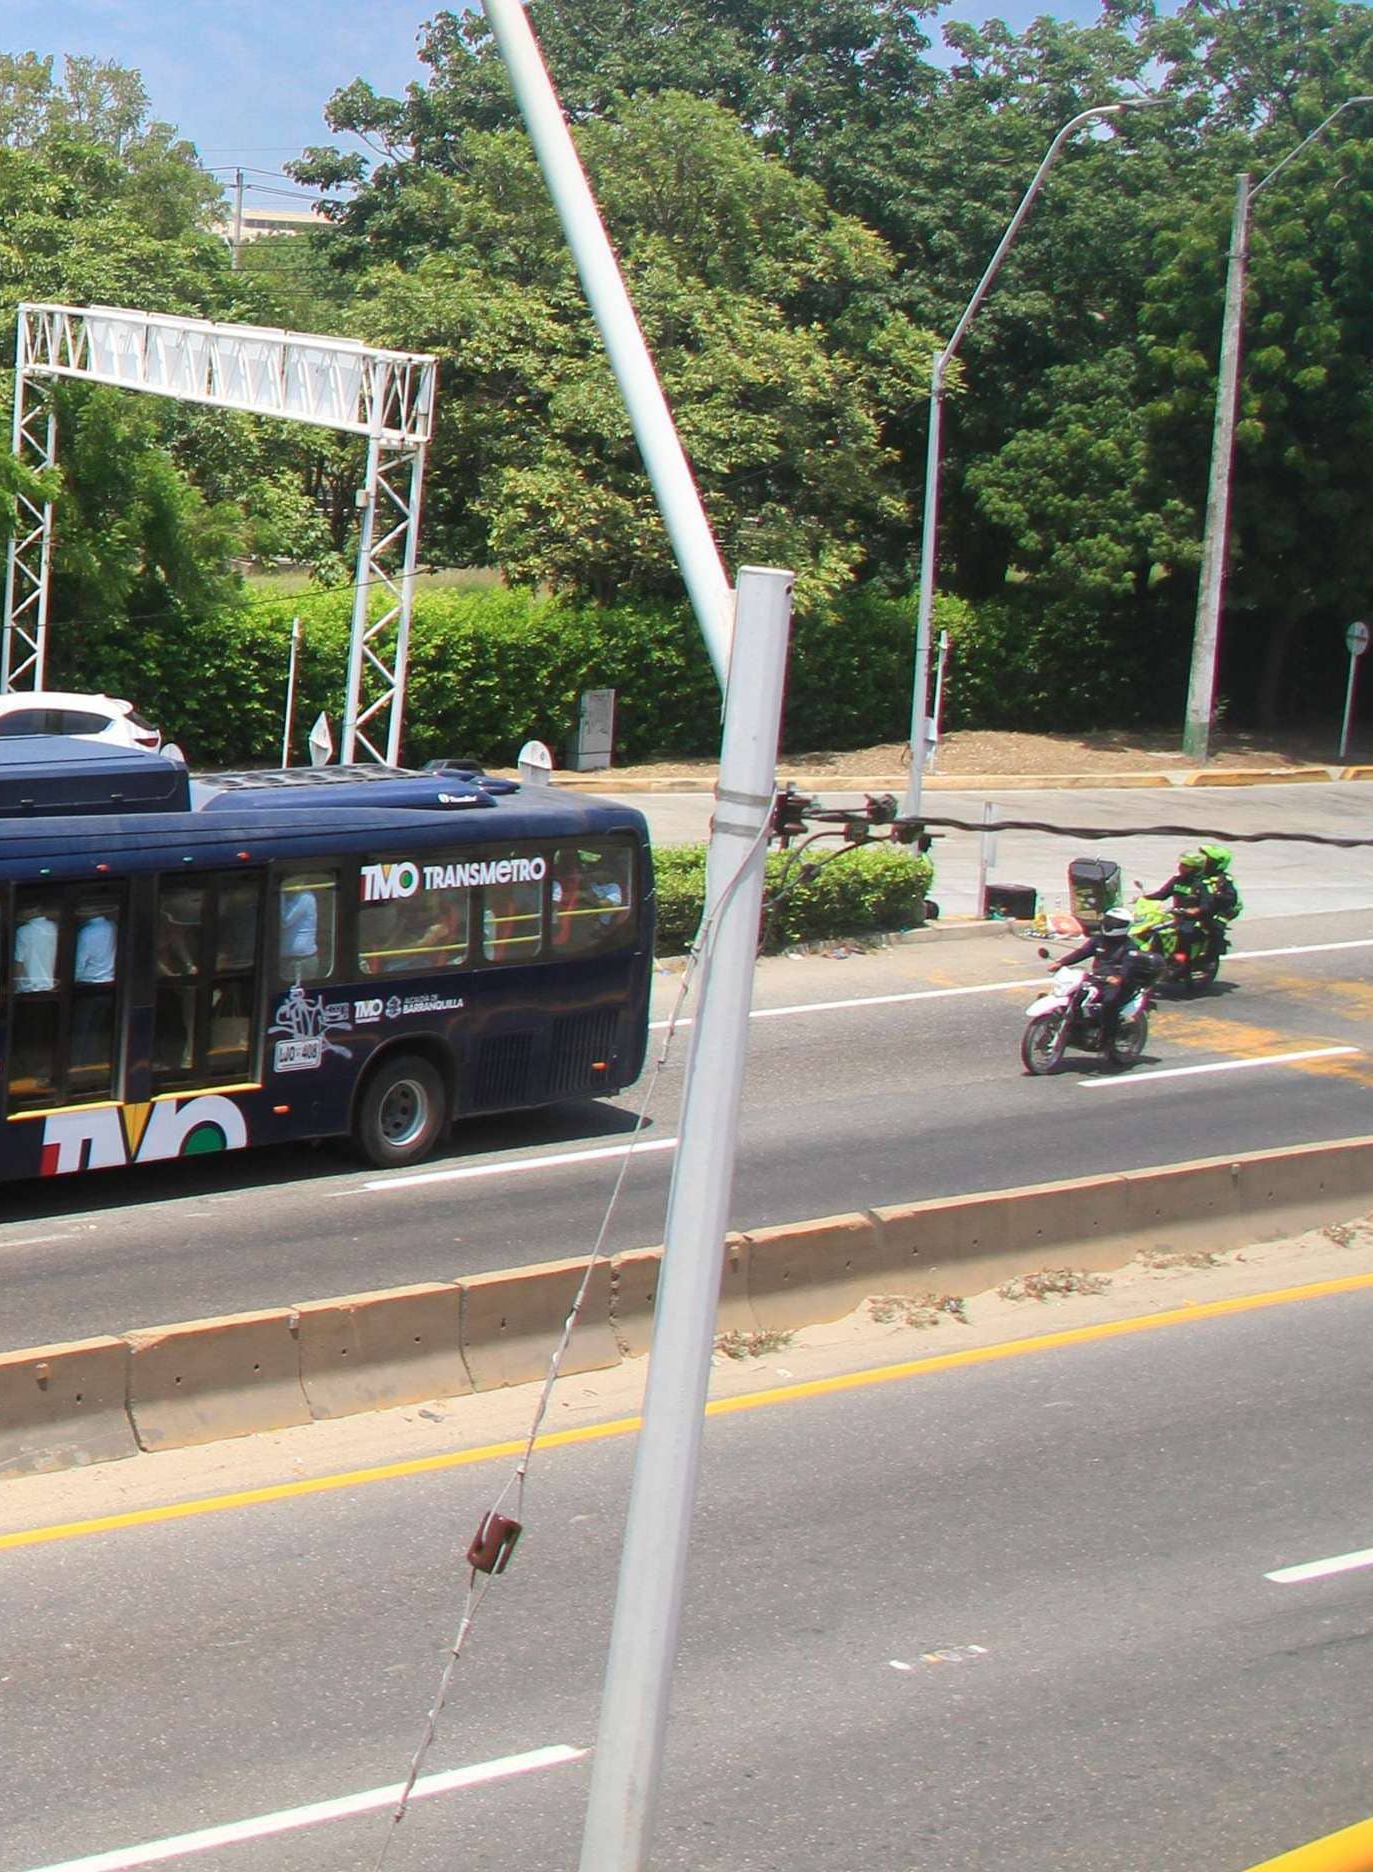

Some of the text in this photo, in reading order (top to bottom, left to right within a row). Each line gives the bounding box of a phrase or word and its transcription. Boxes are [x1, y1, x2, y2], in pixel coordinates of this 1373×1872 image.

[361, 861, 420, 901] TMO
[354, 998, 383, 1018] TMO
[402, 998, 464, 1015] BARRANQUILLA
